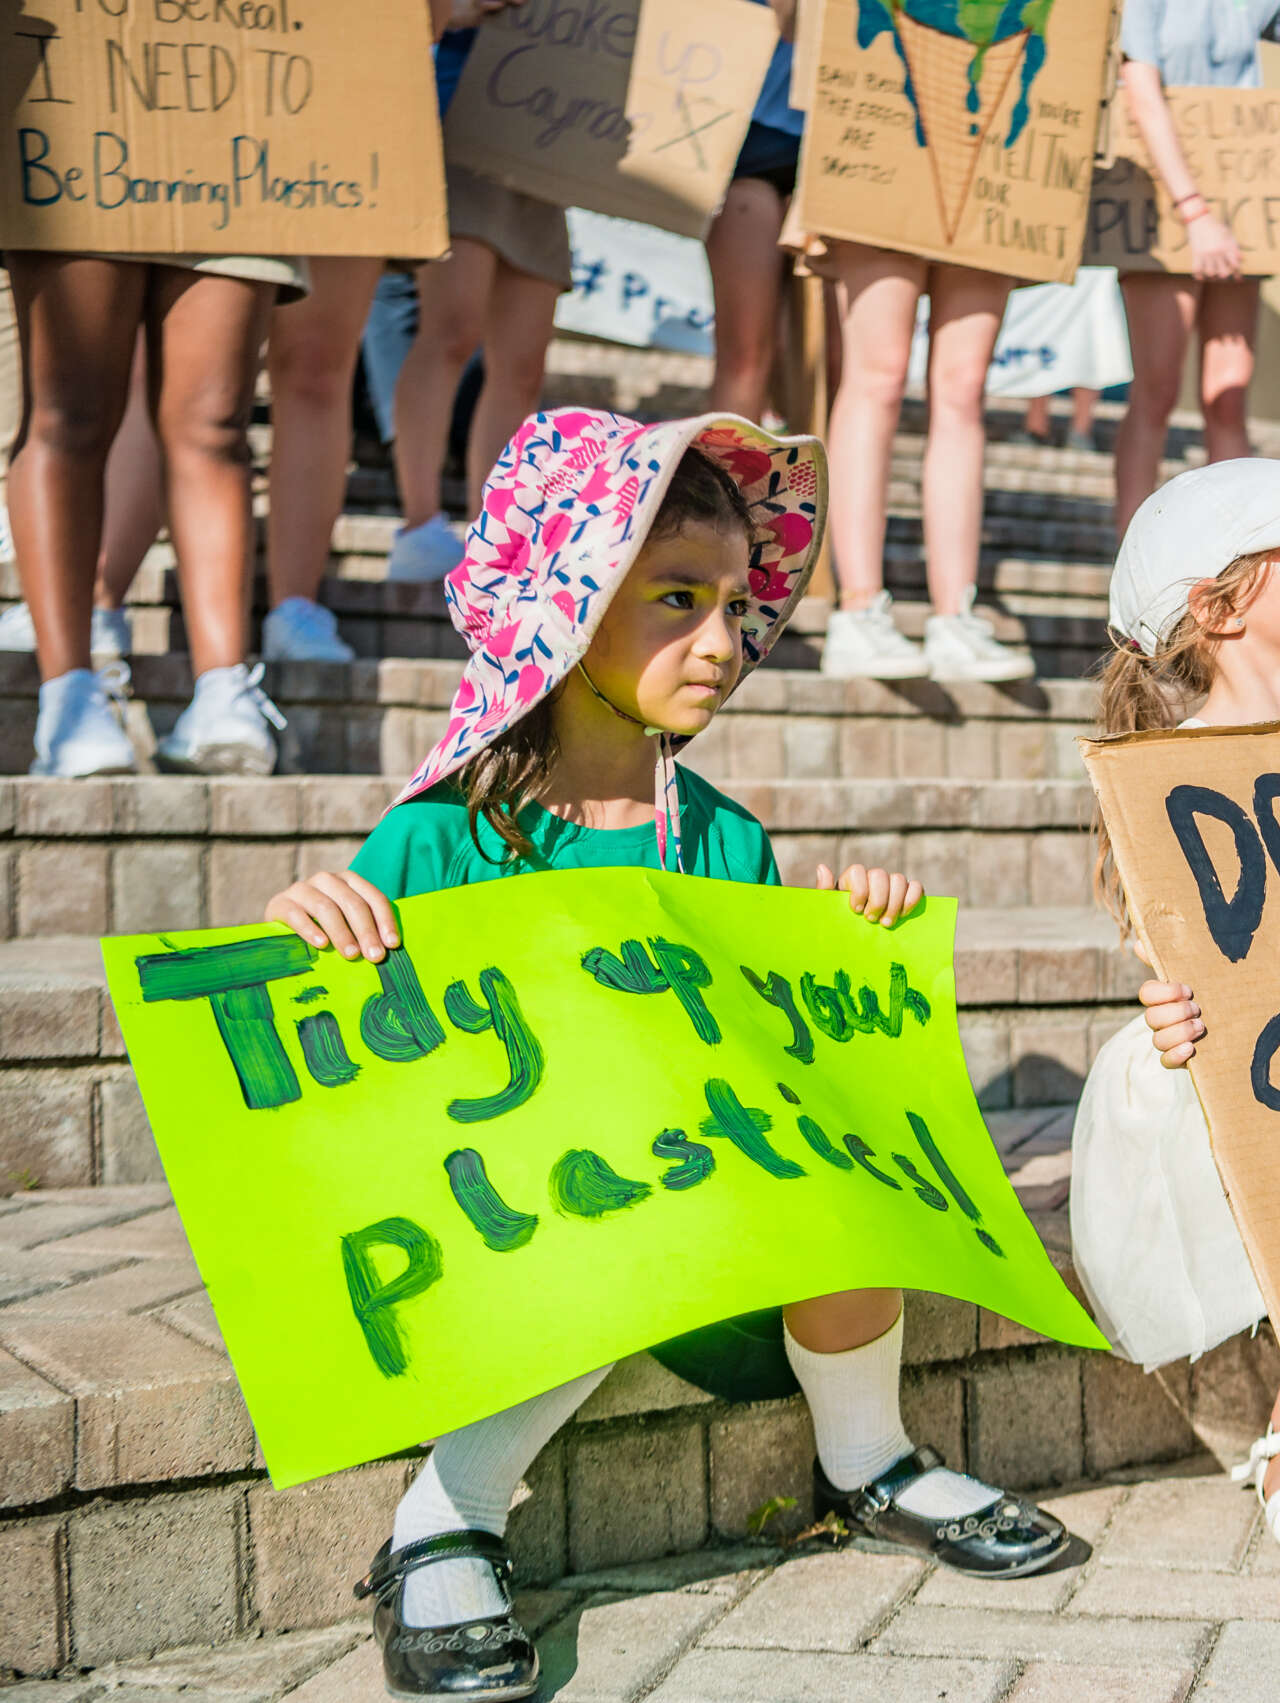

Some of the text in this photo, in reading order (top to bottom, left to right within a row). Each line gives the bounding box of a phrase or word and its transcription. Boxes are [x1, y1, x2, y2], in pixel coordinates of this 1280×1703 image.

[15, 32, 314, 116] I NEED TO
[984, 208, 1068, 260] PLANET
[135, 933, 931, 1123] Tidy up your
